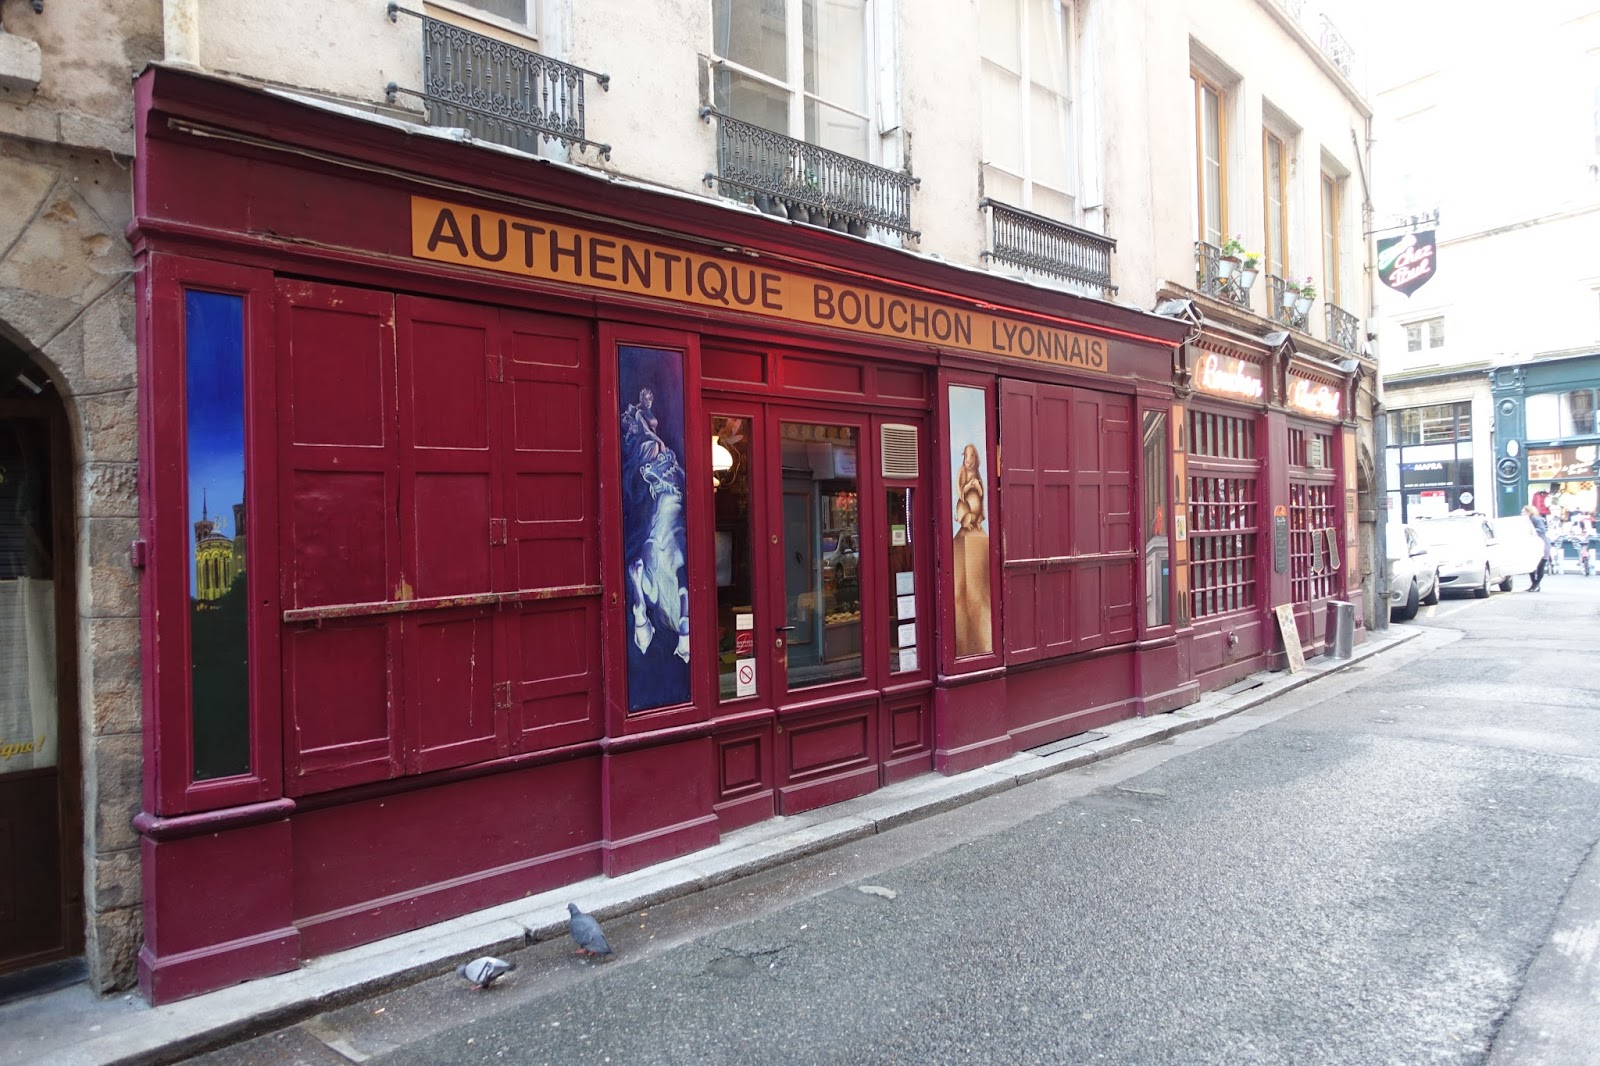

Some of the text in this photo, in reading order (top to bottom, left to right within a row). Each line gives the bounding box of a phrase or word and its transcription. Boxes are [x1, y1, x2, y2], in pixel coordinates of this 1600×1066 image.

[427, 208, 1103, 368] AUTHENTIQUE BOUCHON LYONNAIS
